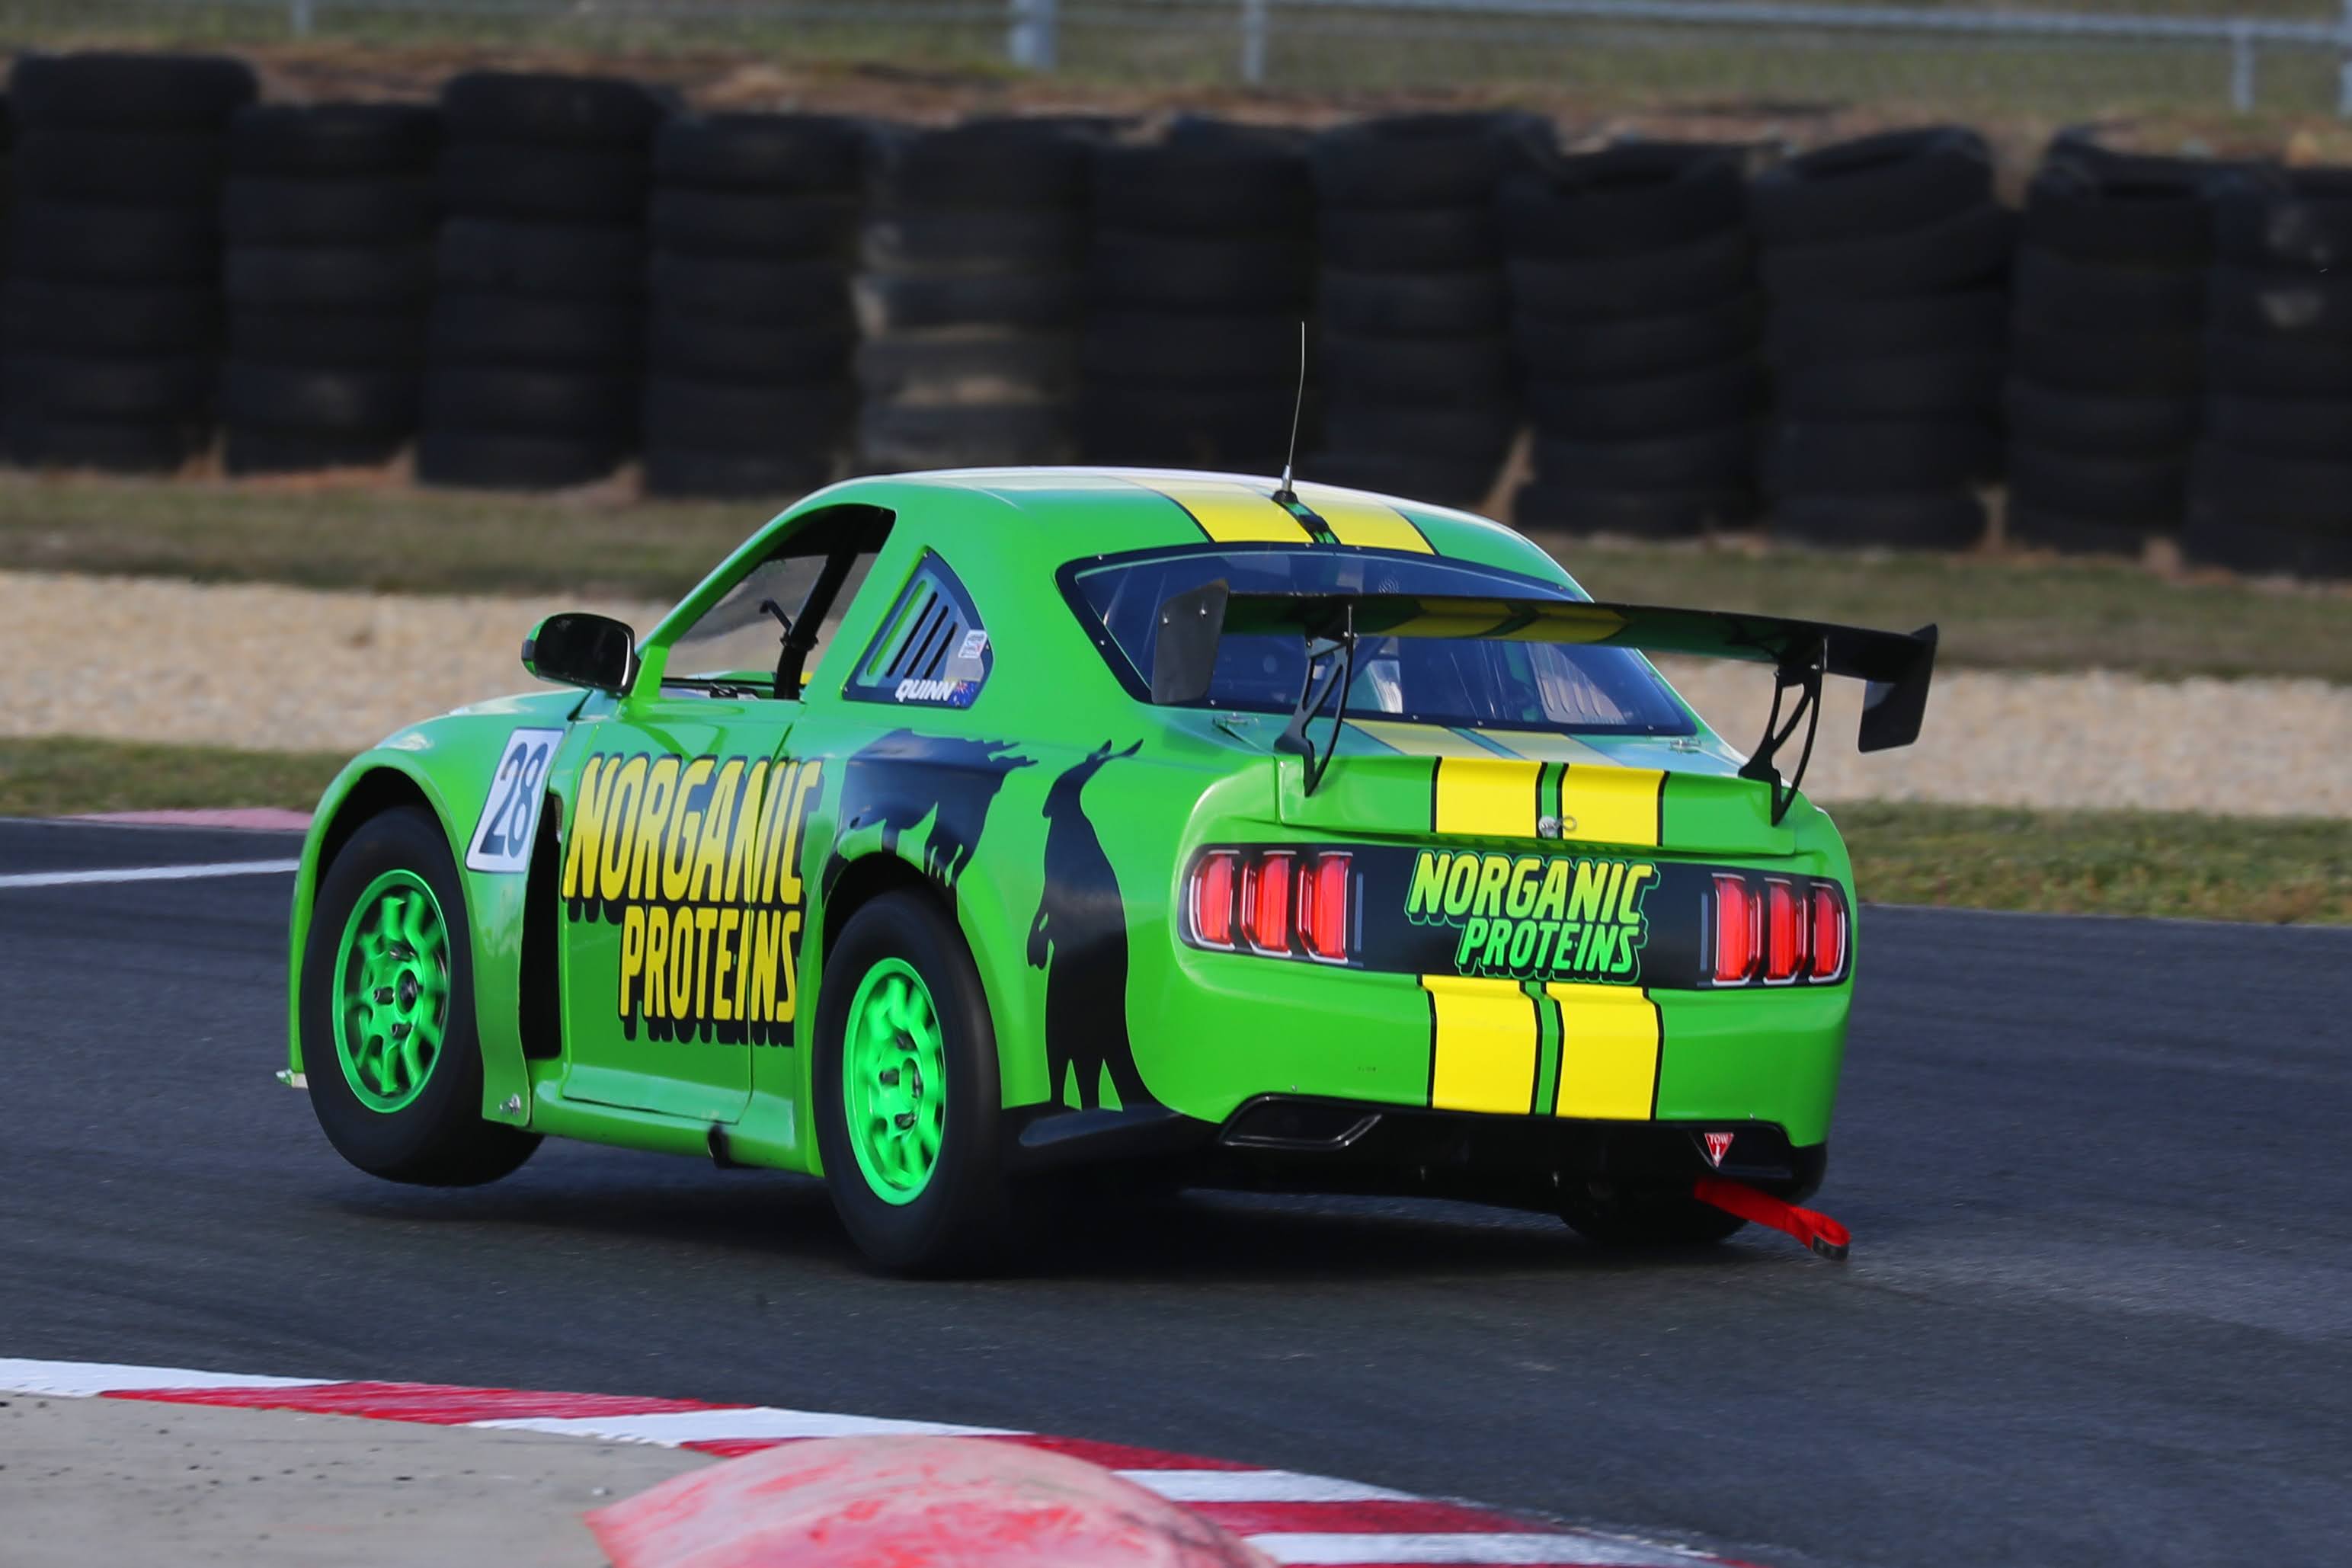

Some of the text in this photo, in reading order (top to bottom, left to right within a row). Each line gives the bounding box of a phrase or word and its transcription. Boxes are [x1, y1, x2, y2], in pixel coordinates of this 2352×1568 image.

[895, 679, 955, 702] QUINN
[478, 742, 549, 859] 28
[563, 754, 822, 904] NORGANIC
[1407, 852, 1654, 925] NORGANIC
[620, 905, 801, 1022] PROTEINS
[1457, 917, 1640, 973] PROTEINS
[1708, 1133, 1730, 1145] TOW
